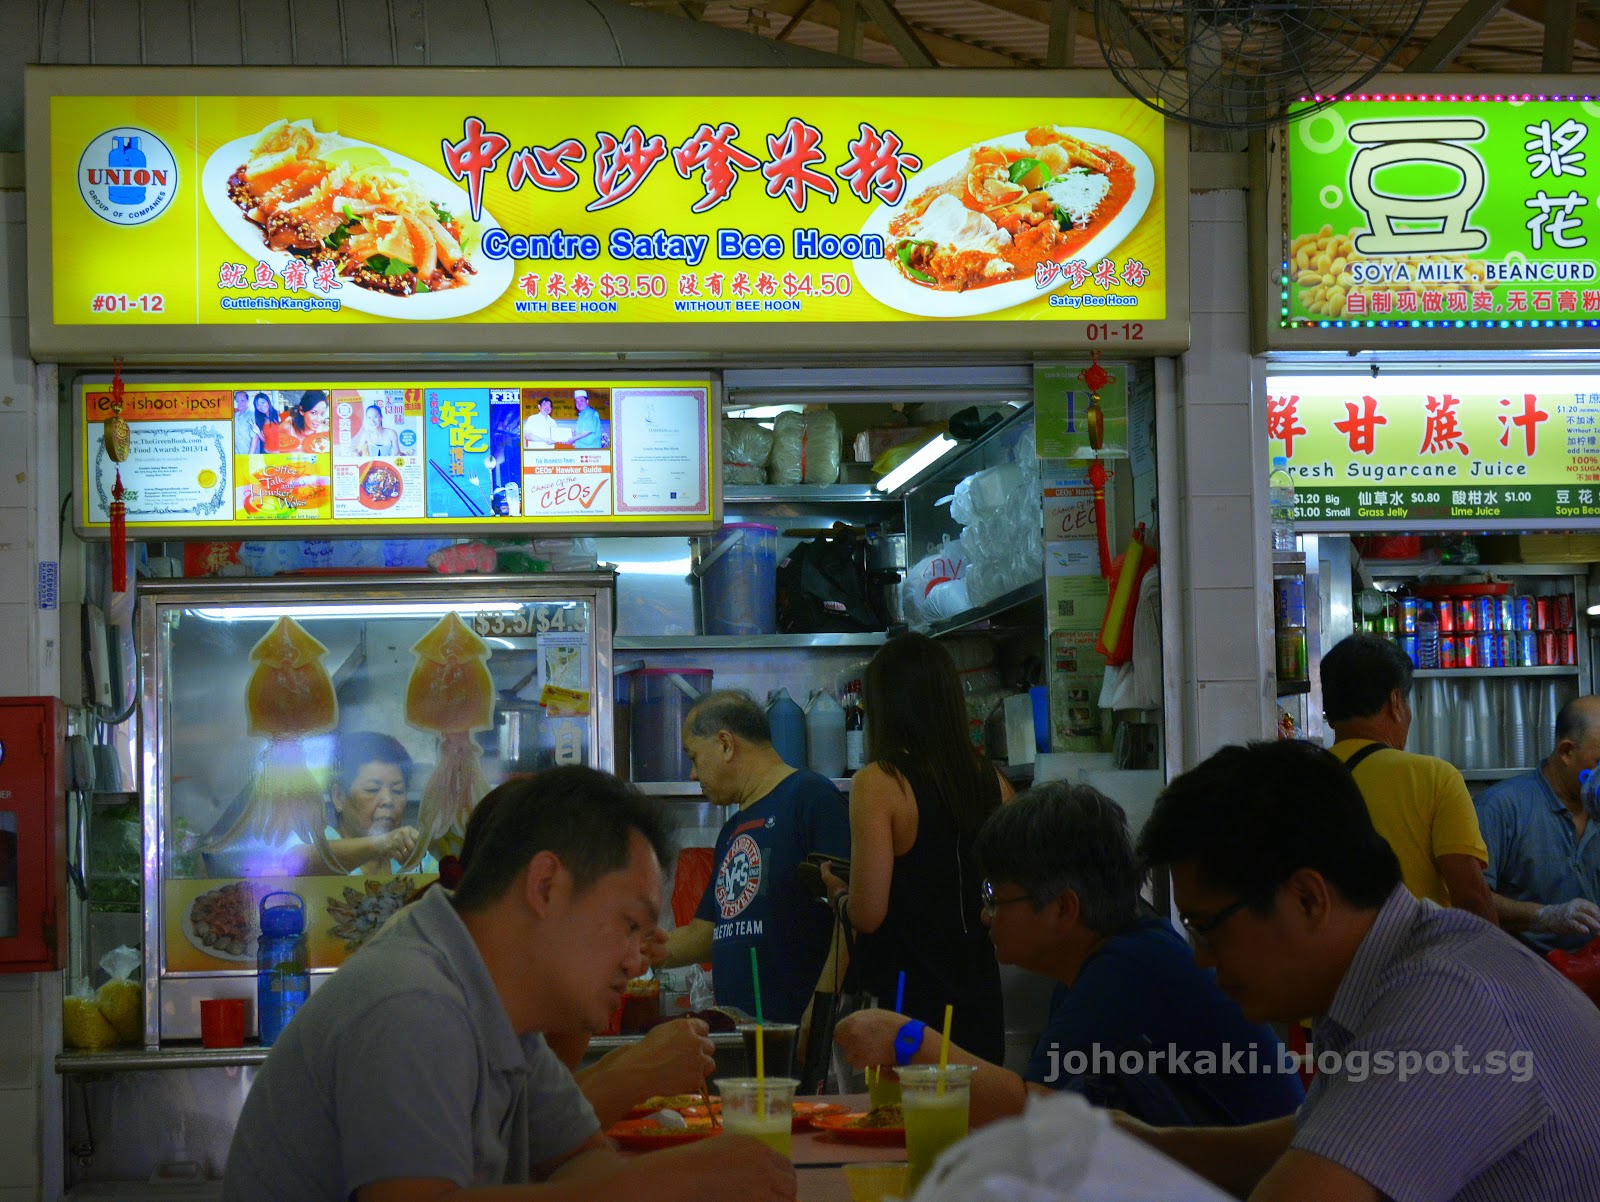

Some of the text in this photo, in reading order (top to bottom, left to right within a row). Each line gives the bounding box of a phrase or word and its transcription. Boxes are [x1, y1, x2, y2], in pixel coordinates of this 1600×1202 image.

[1525, 118, 1588, 178] 浆
[442, 116, 922, 221] 中心沙嗲米粉
[87, 168, 168, 186] UNION
[1349, 119, 1487, 256] 豆
[89, 190, 109, 212] GROUP
[128, 191, 166, 219] COMPANIES
[1525, 190, 1588, 250] 花
[482, 229, 884, 265] Centre Satay Bee Hoon
[1353, 264, 1595, 281] SOYA MILK BEANCURD
[519, 273, 667, 299] 有米粉 $3.50
[783, 272, 852, 298] $4.50
[92, 294, 163, 313] #01-12
[222, 297, 341, 311] Cuttlefish Kangkong
[515, 301, 618, 312] WITH BEE HOON
[674, 300, 801, 311] WITHOUT BEE HOON
[1049, 295, 1138, 307] Satay Bee Hoon
[1086, 323, 1144, 341] 01-12
[490, 391, 520, 402] FBI
[1557, 406, 1578, 414] $1.20
[438, 401, 489, 453] 好吃
[1566, 416, 1595, 425] 不加冰
[1567, 447, 1580, 455] add
[1572, 456, 1598, 465] 100%
[263, 466, 298, 477] Coffee
[534, 465, 602, 474] CEOs' Hawker Guide
[1287, 460, 1527, 481] resh Sugarcane Juice
[259, 476, 284, 489] Talk
[250, 484, 290, 504] Hawker
[541, 484, 590, 508] CEOs
[1076, 488, 1094, 496] Hawk
[1294, 494, 1340, 505] $1.20 Big
[1358, 491, 1440, 506] 仙草水 $0.80
[1452, 490, 1532, 505] 酸柑水 $1.00
[1556, 489, 1593, 504] 豆花
[278, 497, 307, 509] Woks
[1062, 505, 1097, 532] CEO
[1294, 507, 1351, 517] $1.00 Small
[1358, 507, 1384, 517] Grass
[1387, 507, 1408, 518] Jelly
[1451, 507, 1473, 516] Lime
[1475, 506, 1500, 516] Juice
[1555, 505, 1580, 517] Soya
[735, 920, 763, 935] TEAM
